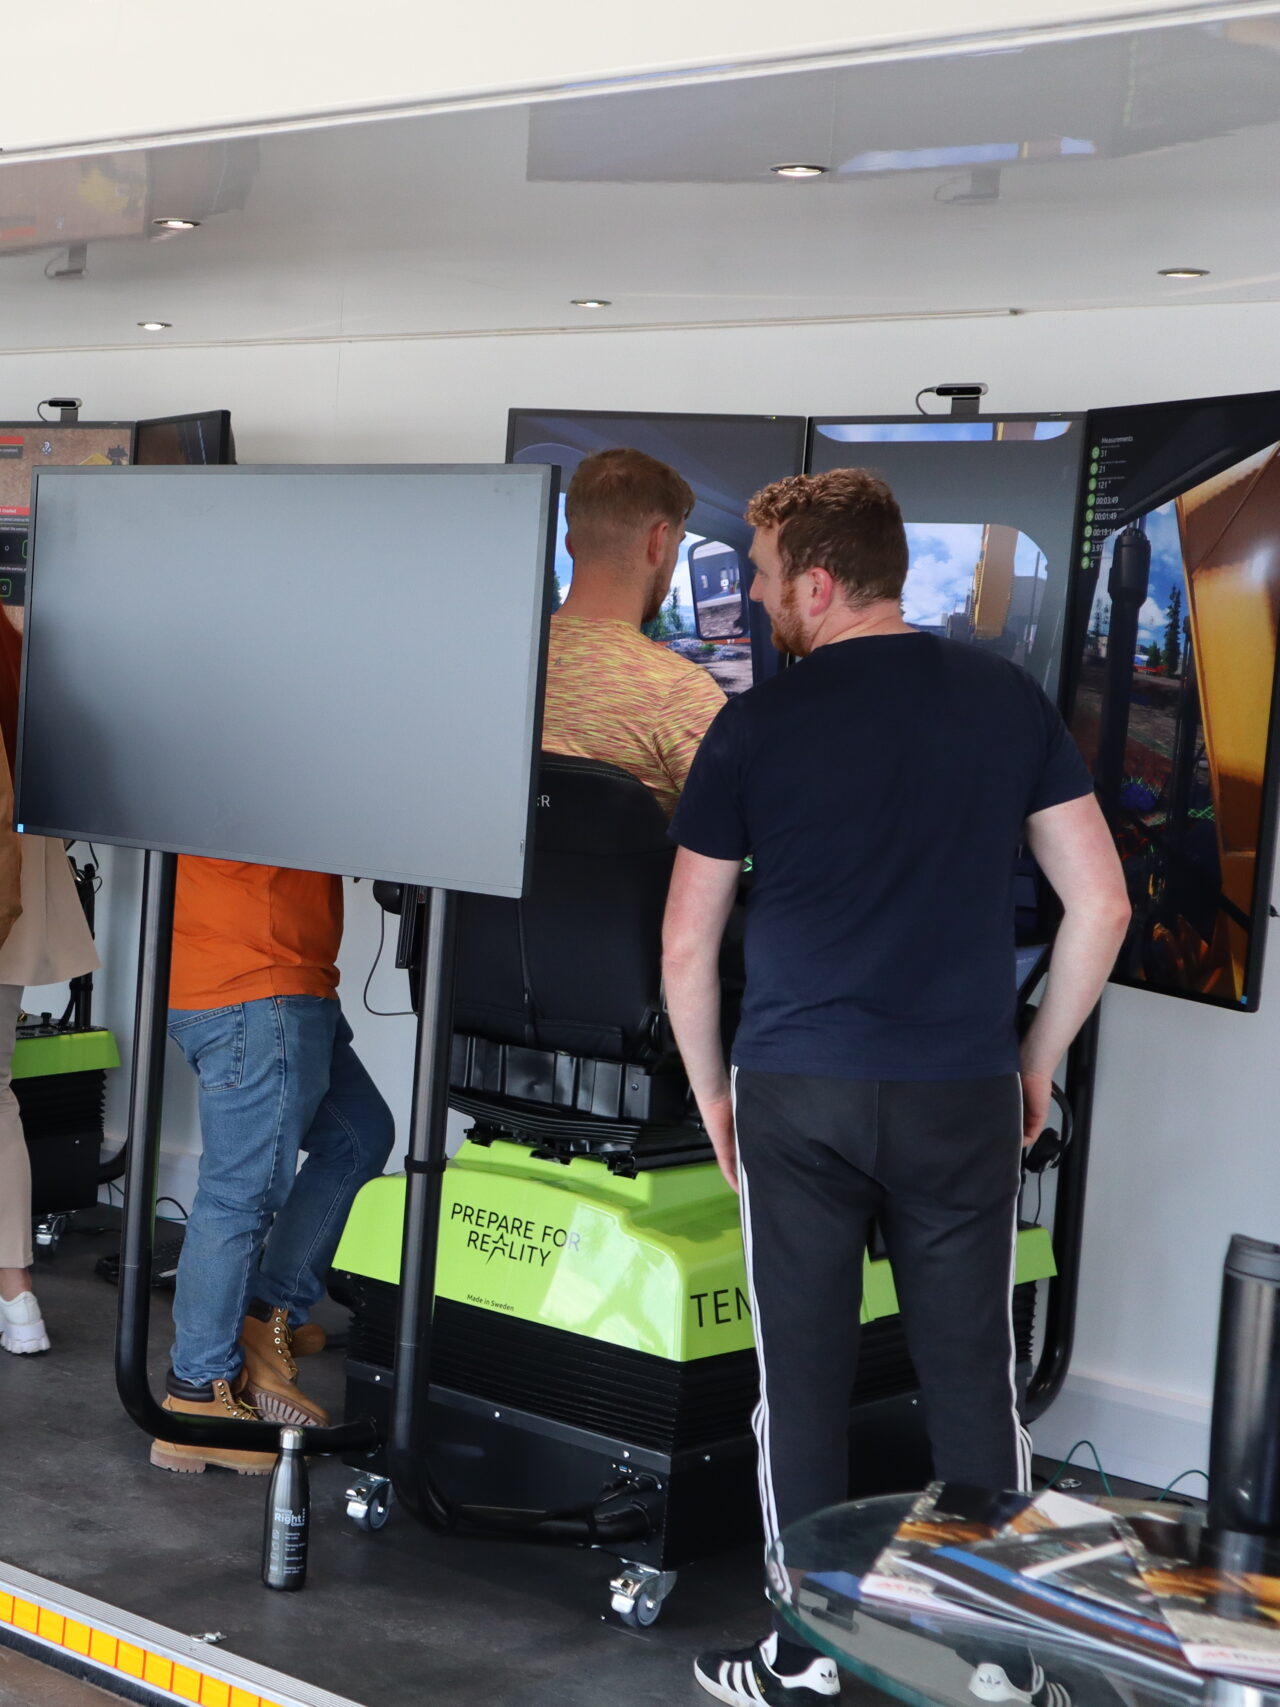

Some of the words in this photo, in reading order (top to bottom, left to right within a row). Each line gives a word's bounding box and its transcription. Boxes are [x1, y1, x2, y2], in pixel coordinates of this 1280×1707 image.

[451, 1202, 535, 1240] PREPARE
[541, 1225, 580, 1252] FOR
[467, 1230, 551, 1267] REALITY
[467, 1294, 483, 1304] Made
[491, 1300, 515, 1312] Sweden
[274, 1512, 302, 1524] Right
